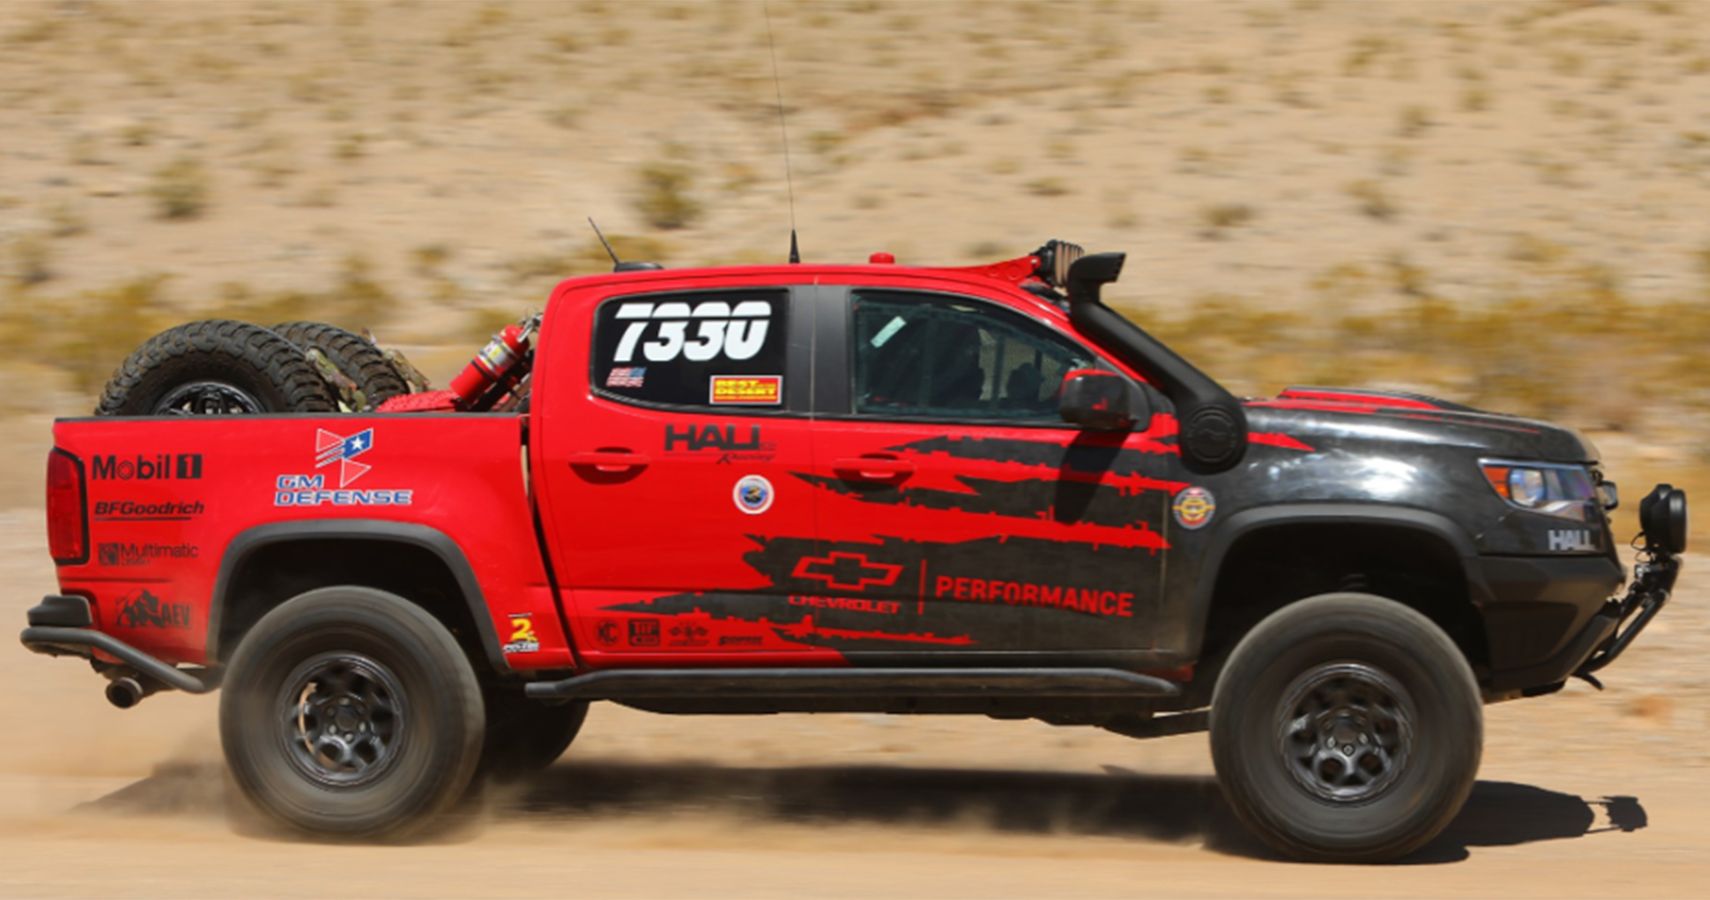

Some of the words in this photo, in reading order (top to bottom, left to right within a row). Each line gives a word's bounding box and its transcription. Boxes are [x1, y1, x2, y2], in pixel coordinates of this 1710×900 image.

[613, 301, 772, 362] 7330
[92, 454, 171, 480] Mobil
[277, 474, 325, 489] GM
[274, 489, 413, 506] DEFENSE
[94, 500, 205, 516] BFGoodrich
[1548, 529, 1595, 551] HALL
[788, 595, 899, 614] CHEVROLET
[935, 575, 1135, 617] PERFORMANCE
